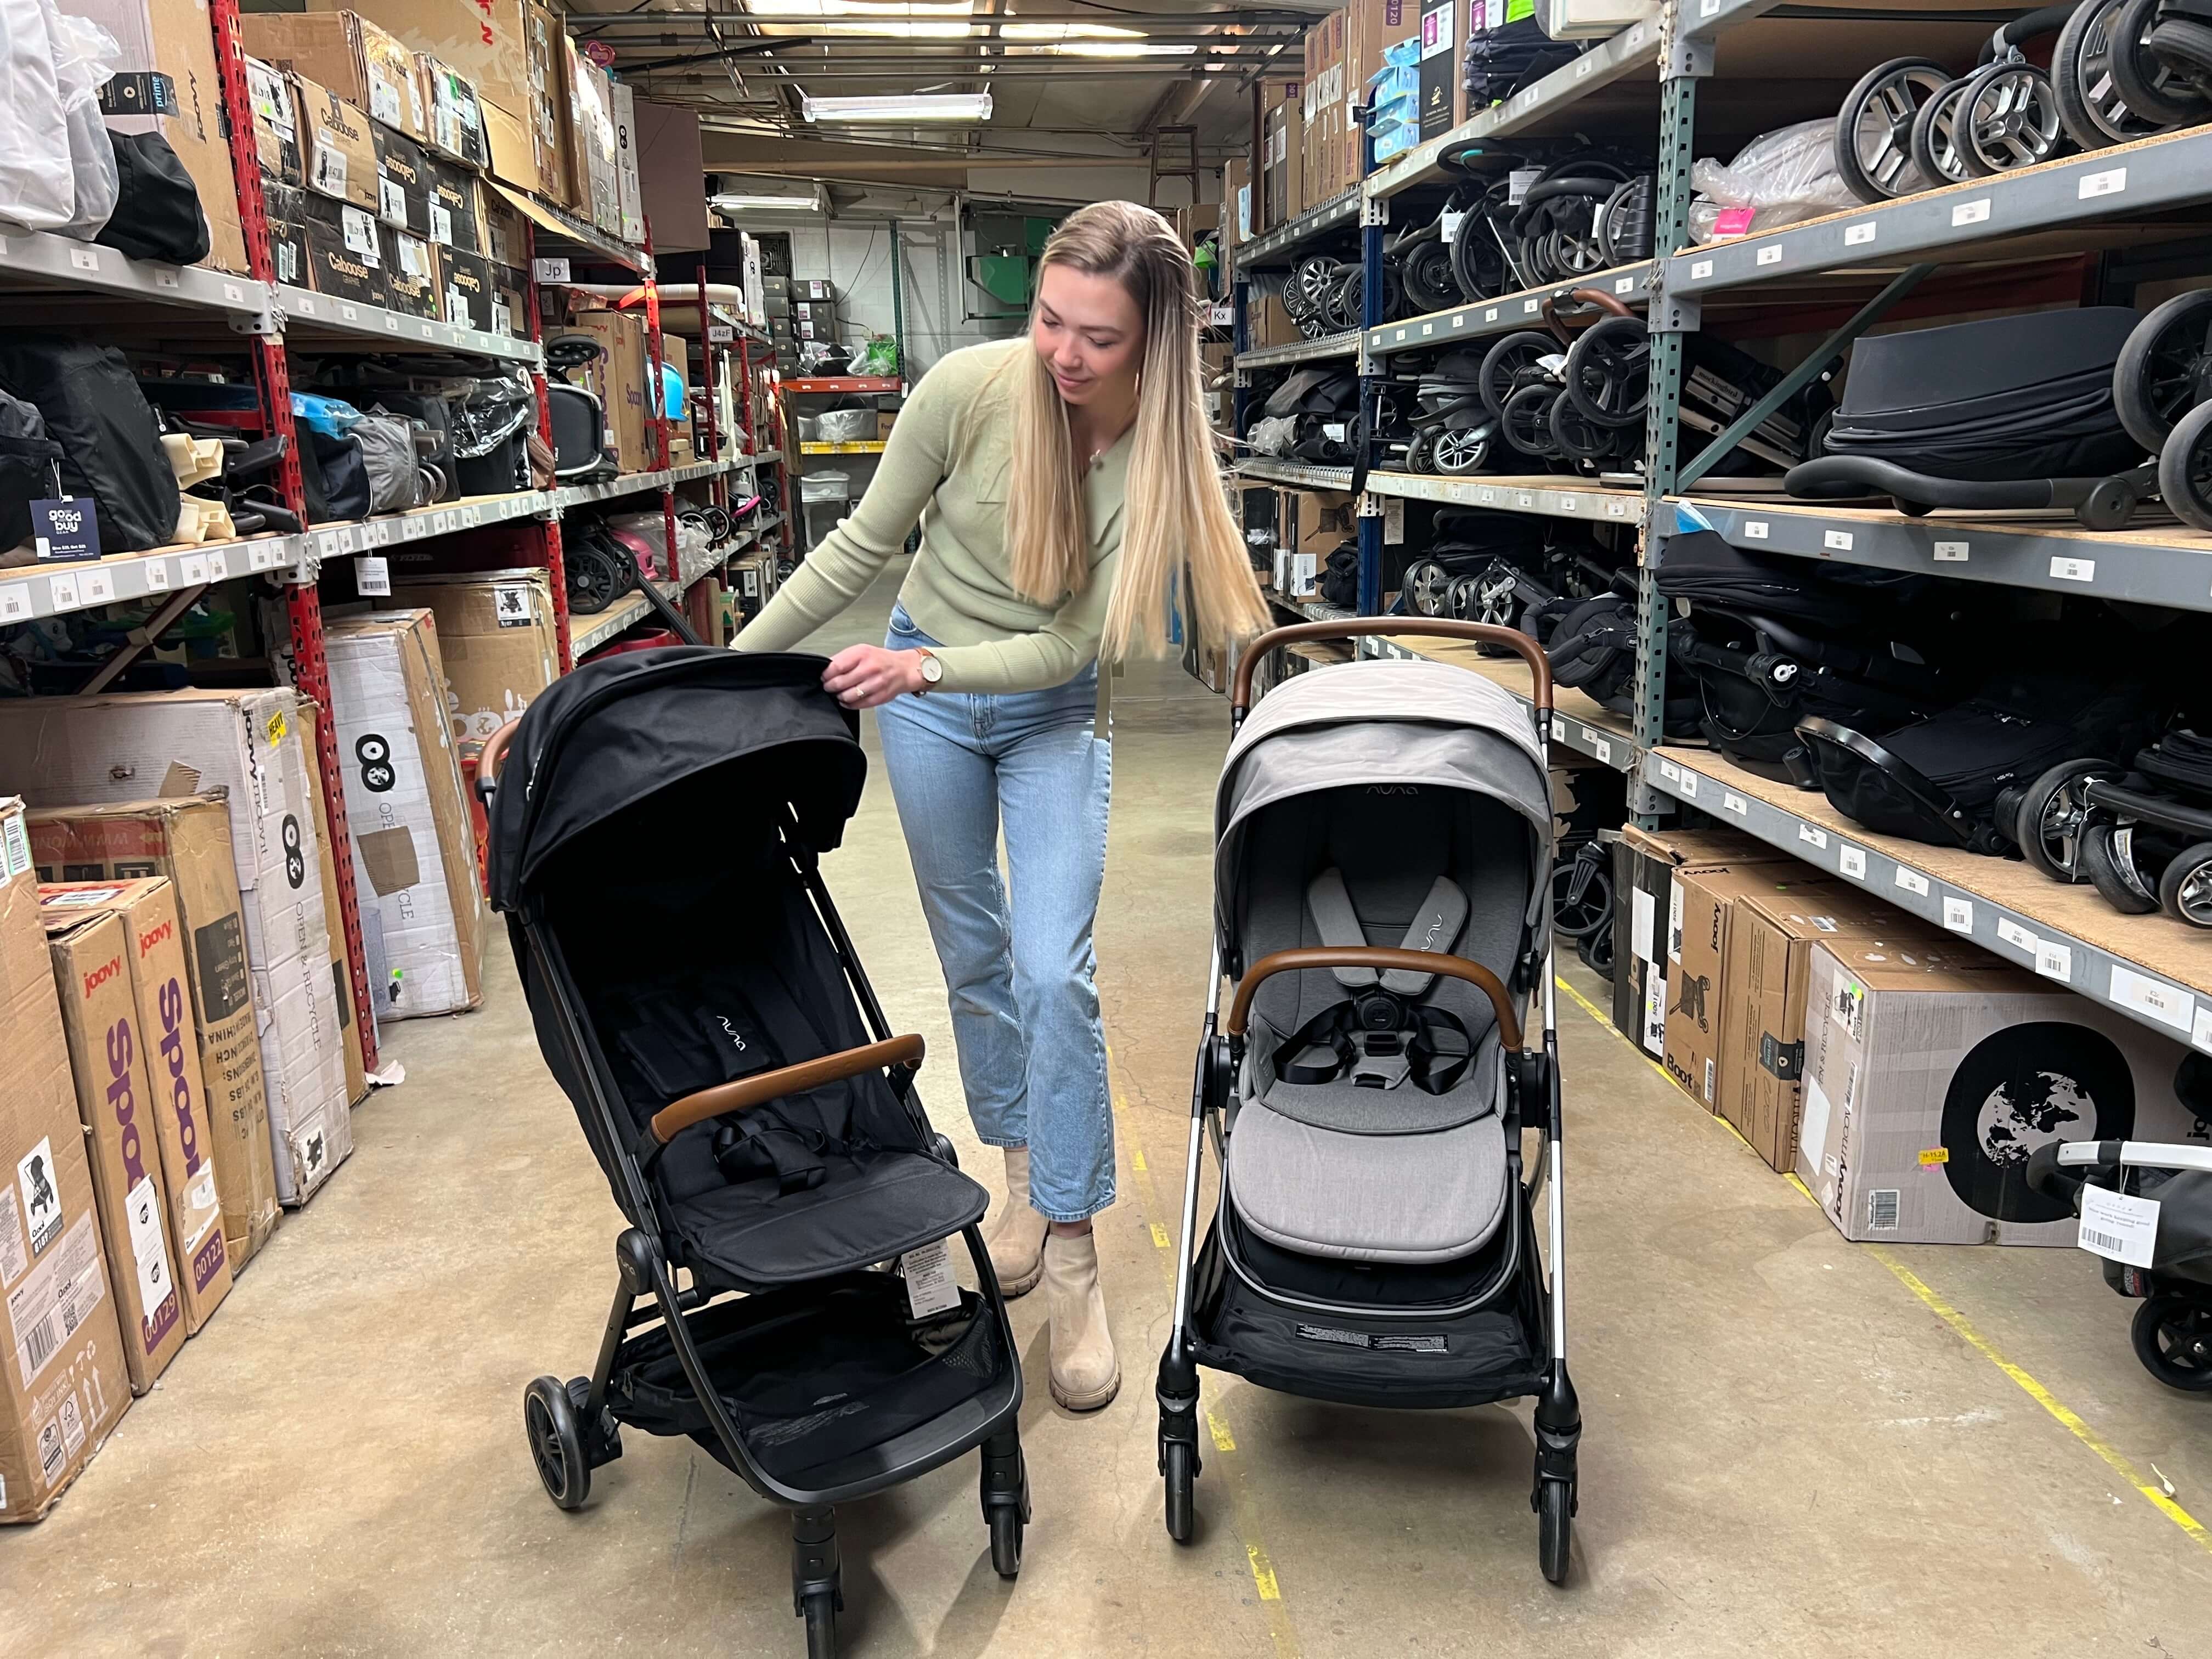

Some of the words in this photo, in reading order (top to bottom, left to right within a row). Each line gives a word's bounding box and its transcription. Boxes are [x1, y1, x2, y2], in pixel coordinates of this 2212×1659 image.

[152, 76, 164, 108] prime
[258, 87, 270, 101] 8147
[188, 69, 207, 144] joovy
[321, 108, 359, 142] Caboose
[385, 154, 416, 184] Caboose
[437, 184, 463, 210] Caboose
[328, 251, 369, 279] Caboose
[545, 264, 561, 279] Jp
[388, 273, 421, 298] Caboose
[454, 272, 480, 293] Caboose
[1214, 311, 1226, 320] Kx
[1699, 372, 1738, 397] mockingbird
[49, 510, 81, 522] good
[55, 521, 78, 533] buy
[281, 654, 298, 685] joo
[268, 711, 284, 737] HEAVY
[1367, 786, 1418, 795] nuna
[379, 803, 396, 828] OPE
[139, 919, 172, 958] joovy
[295, 901, 307, 950] OPEN
[1420, 913, 1443, 952] nun
[1711, 902, 1721, 953] joovy
[300, 955, 308, 966] &
[83, 955, 121, 999] joovy
[303, 971, 321, 1051] RECYCLE
[1821, 992, 1831, 1053] RECYCLE
[208, 1028, 235, 1045] CHINA
[716, 1015, 746, 1051] nuna
[159, 977, 200, 1178] Spoo
[1667, 1053, 1694, 1090] Boot
[1833, 1111, 1851, 1223] joovymoov
[140, 1207, 149, 1223] ups
[32, 1220, 45, 1238] Qool
[34, 1232, 48, 1254] 8189
[196, 1237, 222, 1282] 00122
[618, 1255, 636, 1276] nuna
[151, 1266, 160, 1282] ups
[11, 1288, 24, 1306] joovy
[58, 1279, 71, 1299] Qool
[145, 1293, 176, 1342] 00129
[57, 1383, 67, 1397] INK
